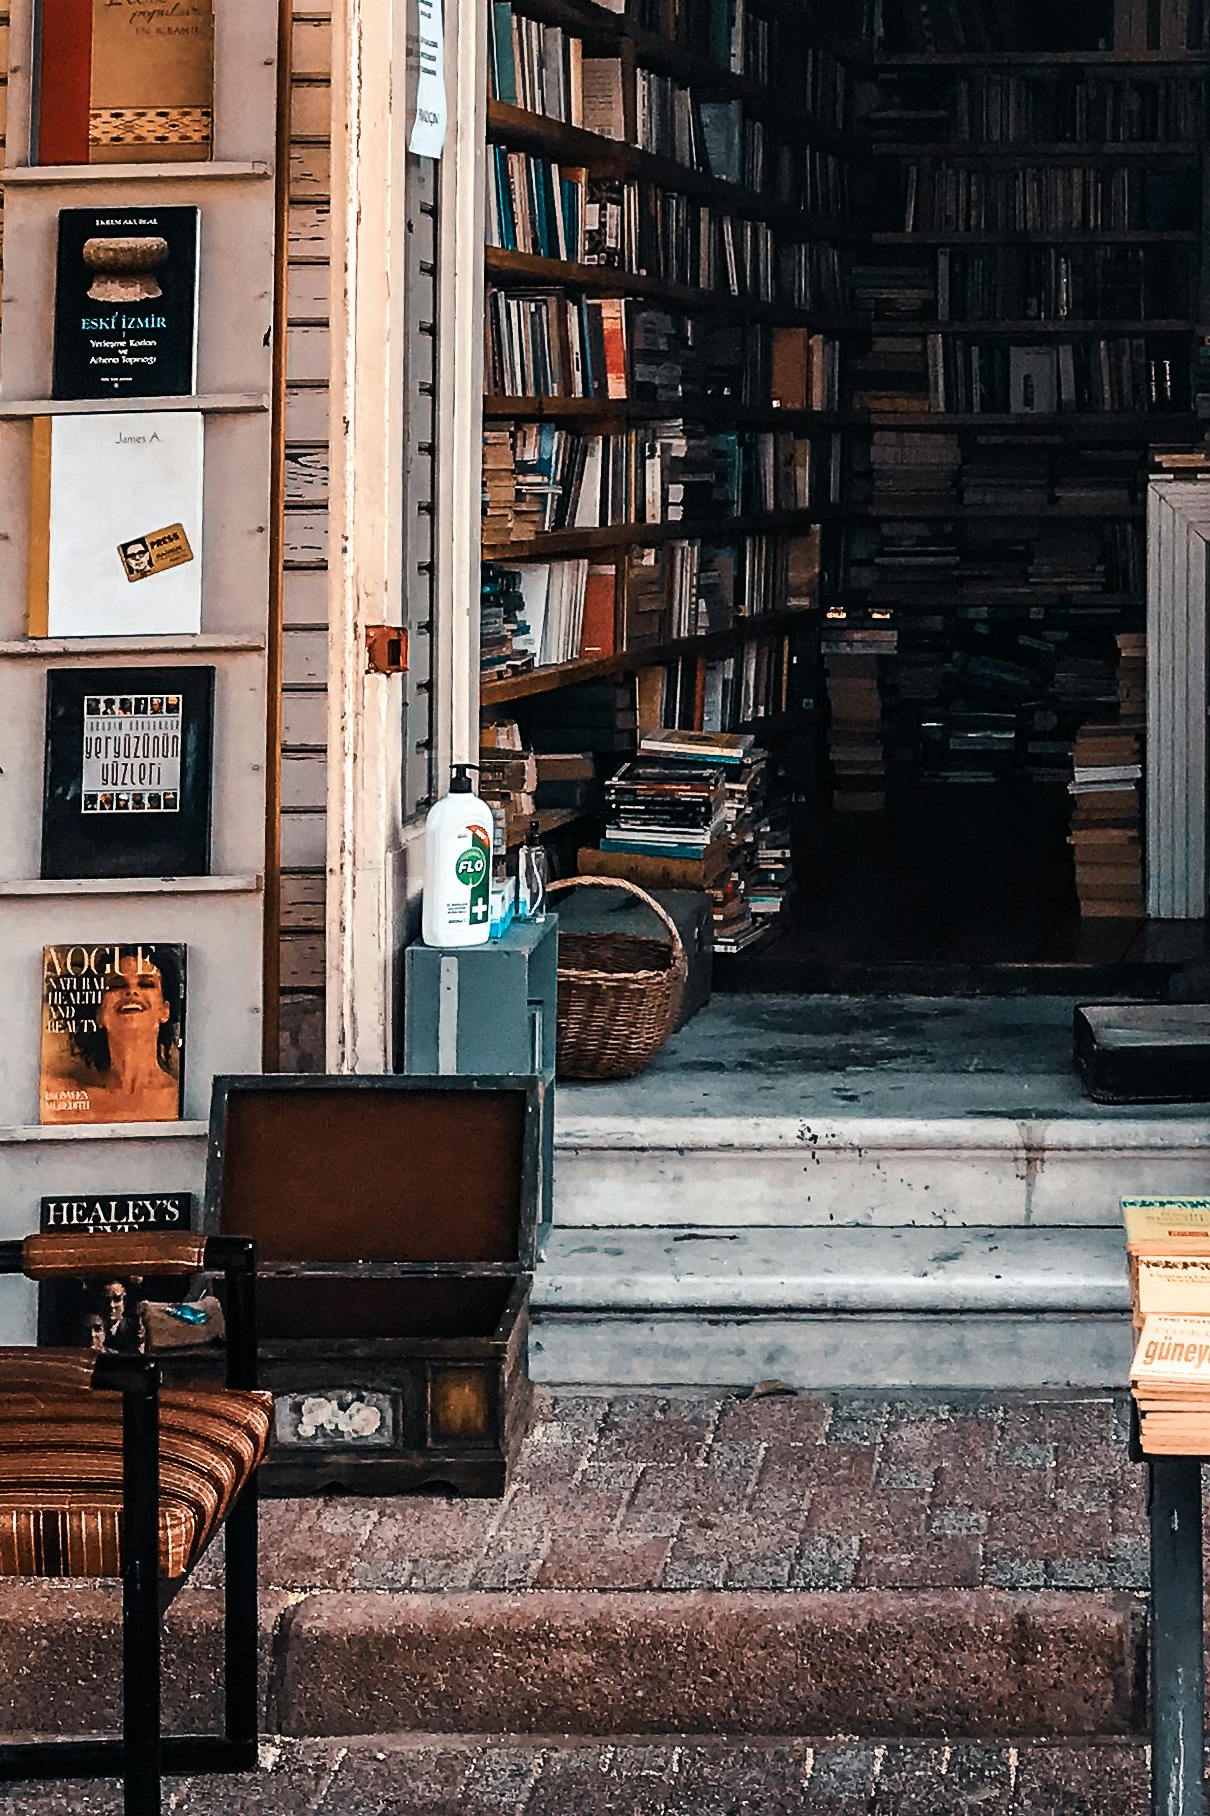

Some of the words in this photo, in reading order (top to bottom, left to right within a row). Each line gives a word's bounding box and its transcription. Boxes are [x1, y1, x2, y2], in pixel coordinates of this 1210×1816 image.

[122, 313, 167, 328] İZMİR
[115, 432, 147, 444] James
[85, 733, 180, 759] yeryüzünün
[101, 761, 161, 786] yüzleri
[458, 859, 485, 874] FLO
[45, 945, 159, 977] VOGUE
[48, 977, 110, 992] NATURAL
[48, 990, 103, 1006] HEALTH
[48, 1005, 76, 1020] AND
[48, 1019, 98, 1034] BEAUTY
[47, 1198, 180, 1226] HEALEY'S
